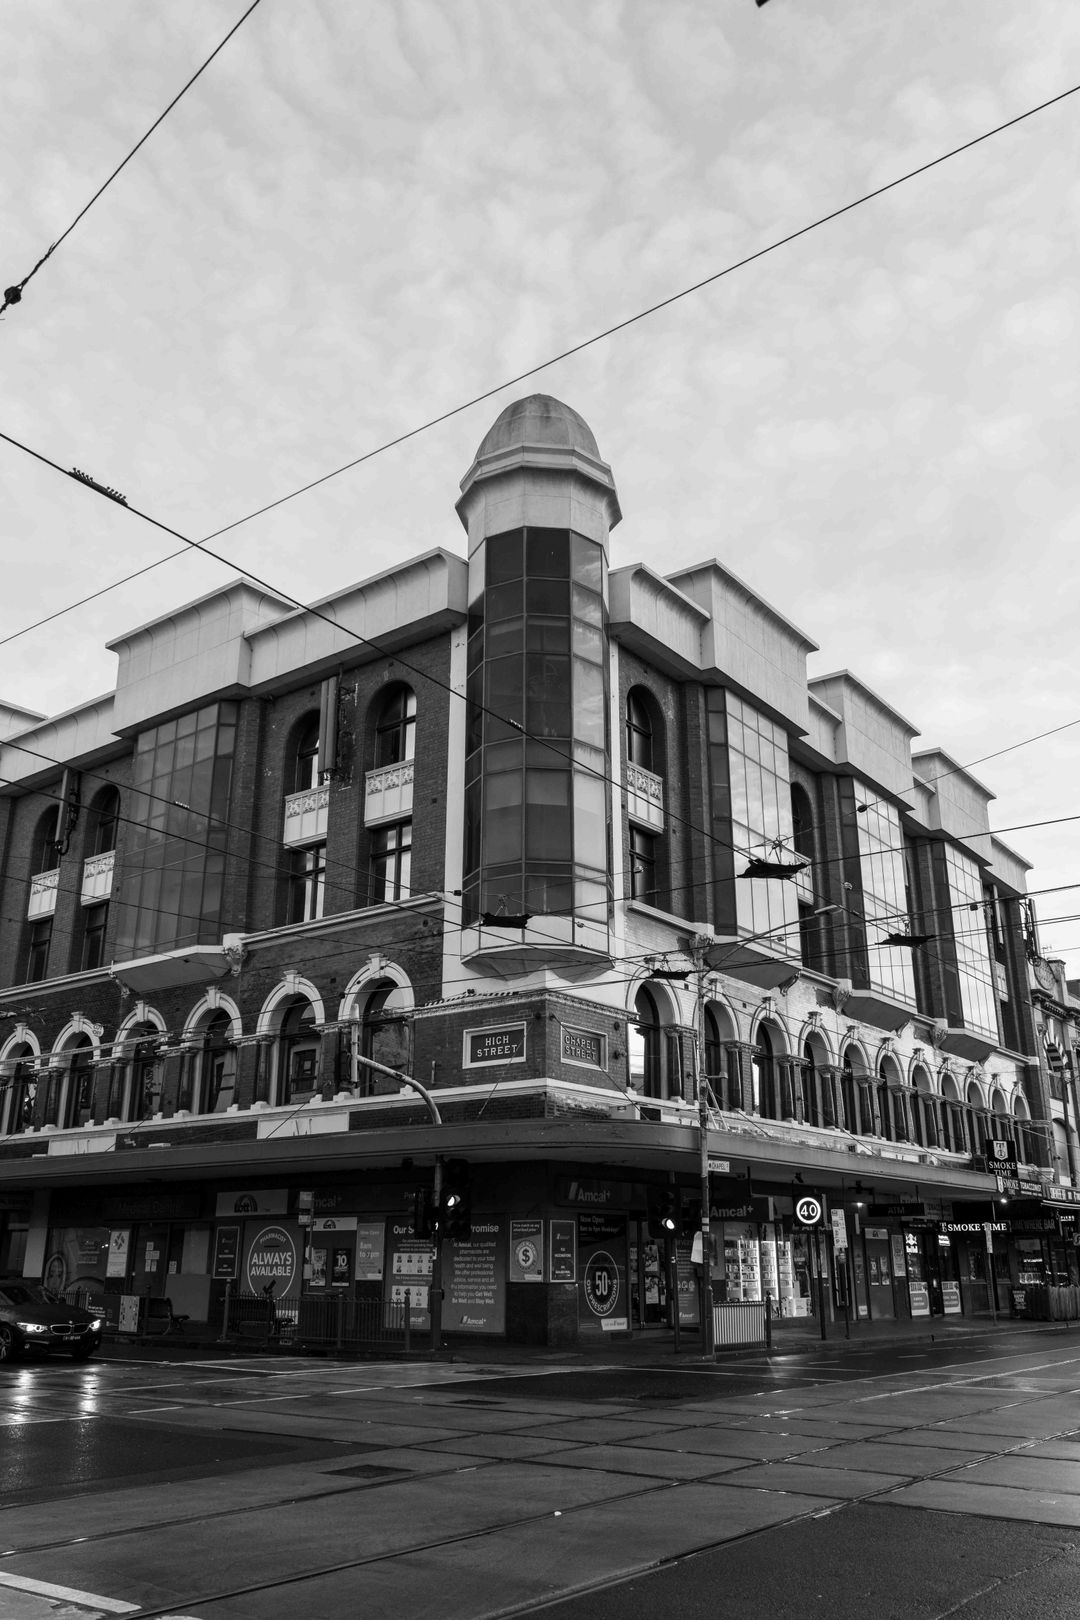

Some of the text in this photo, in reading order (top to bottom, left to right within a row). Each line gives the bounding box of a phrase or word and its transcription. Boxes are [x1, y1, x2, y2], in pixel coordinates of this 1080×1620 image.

[485, 1035, 509, 1046] HIGH
[565, 1035, 597, 1050] CHAPEL
[476, 1044, 518, 1058] STREET
[565, 1045, 597, 1061] STREET
[988, 1161, 1017, 1170] SMOKE
[993, 1169, 1012, 1177] TIME
[800, 1204, 817, 1217] 40
[393, 1225, 406, 1234] Our
[470, 1224, 499, 1233] romise
[947, 1223, 981, 1232] SMOKE
[259, 1233, 287, 1244] PHARMACIST
[251, 1252, 292, 1265] ALWAYS
[336, 1255, 347, 1266] 10
[250, 1266, 291, 1276] AVAILABLE
[589, 1279, 617, 1312] PRESCRIPTIONS
